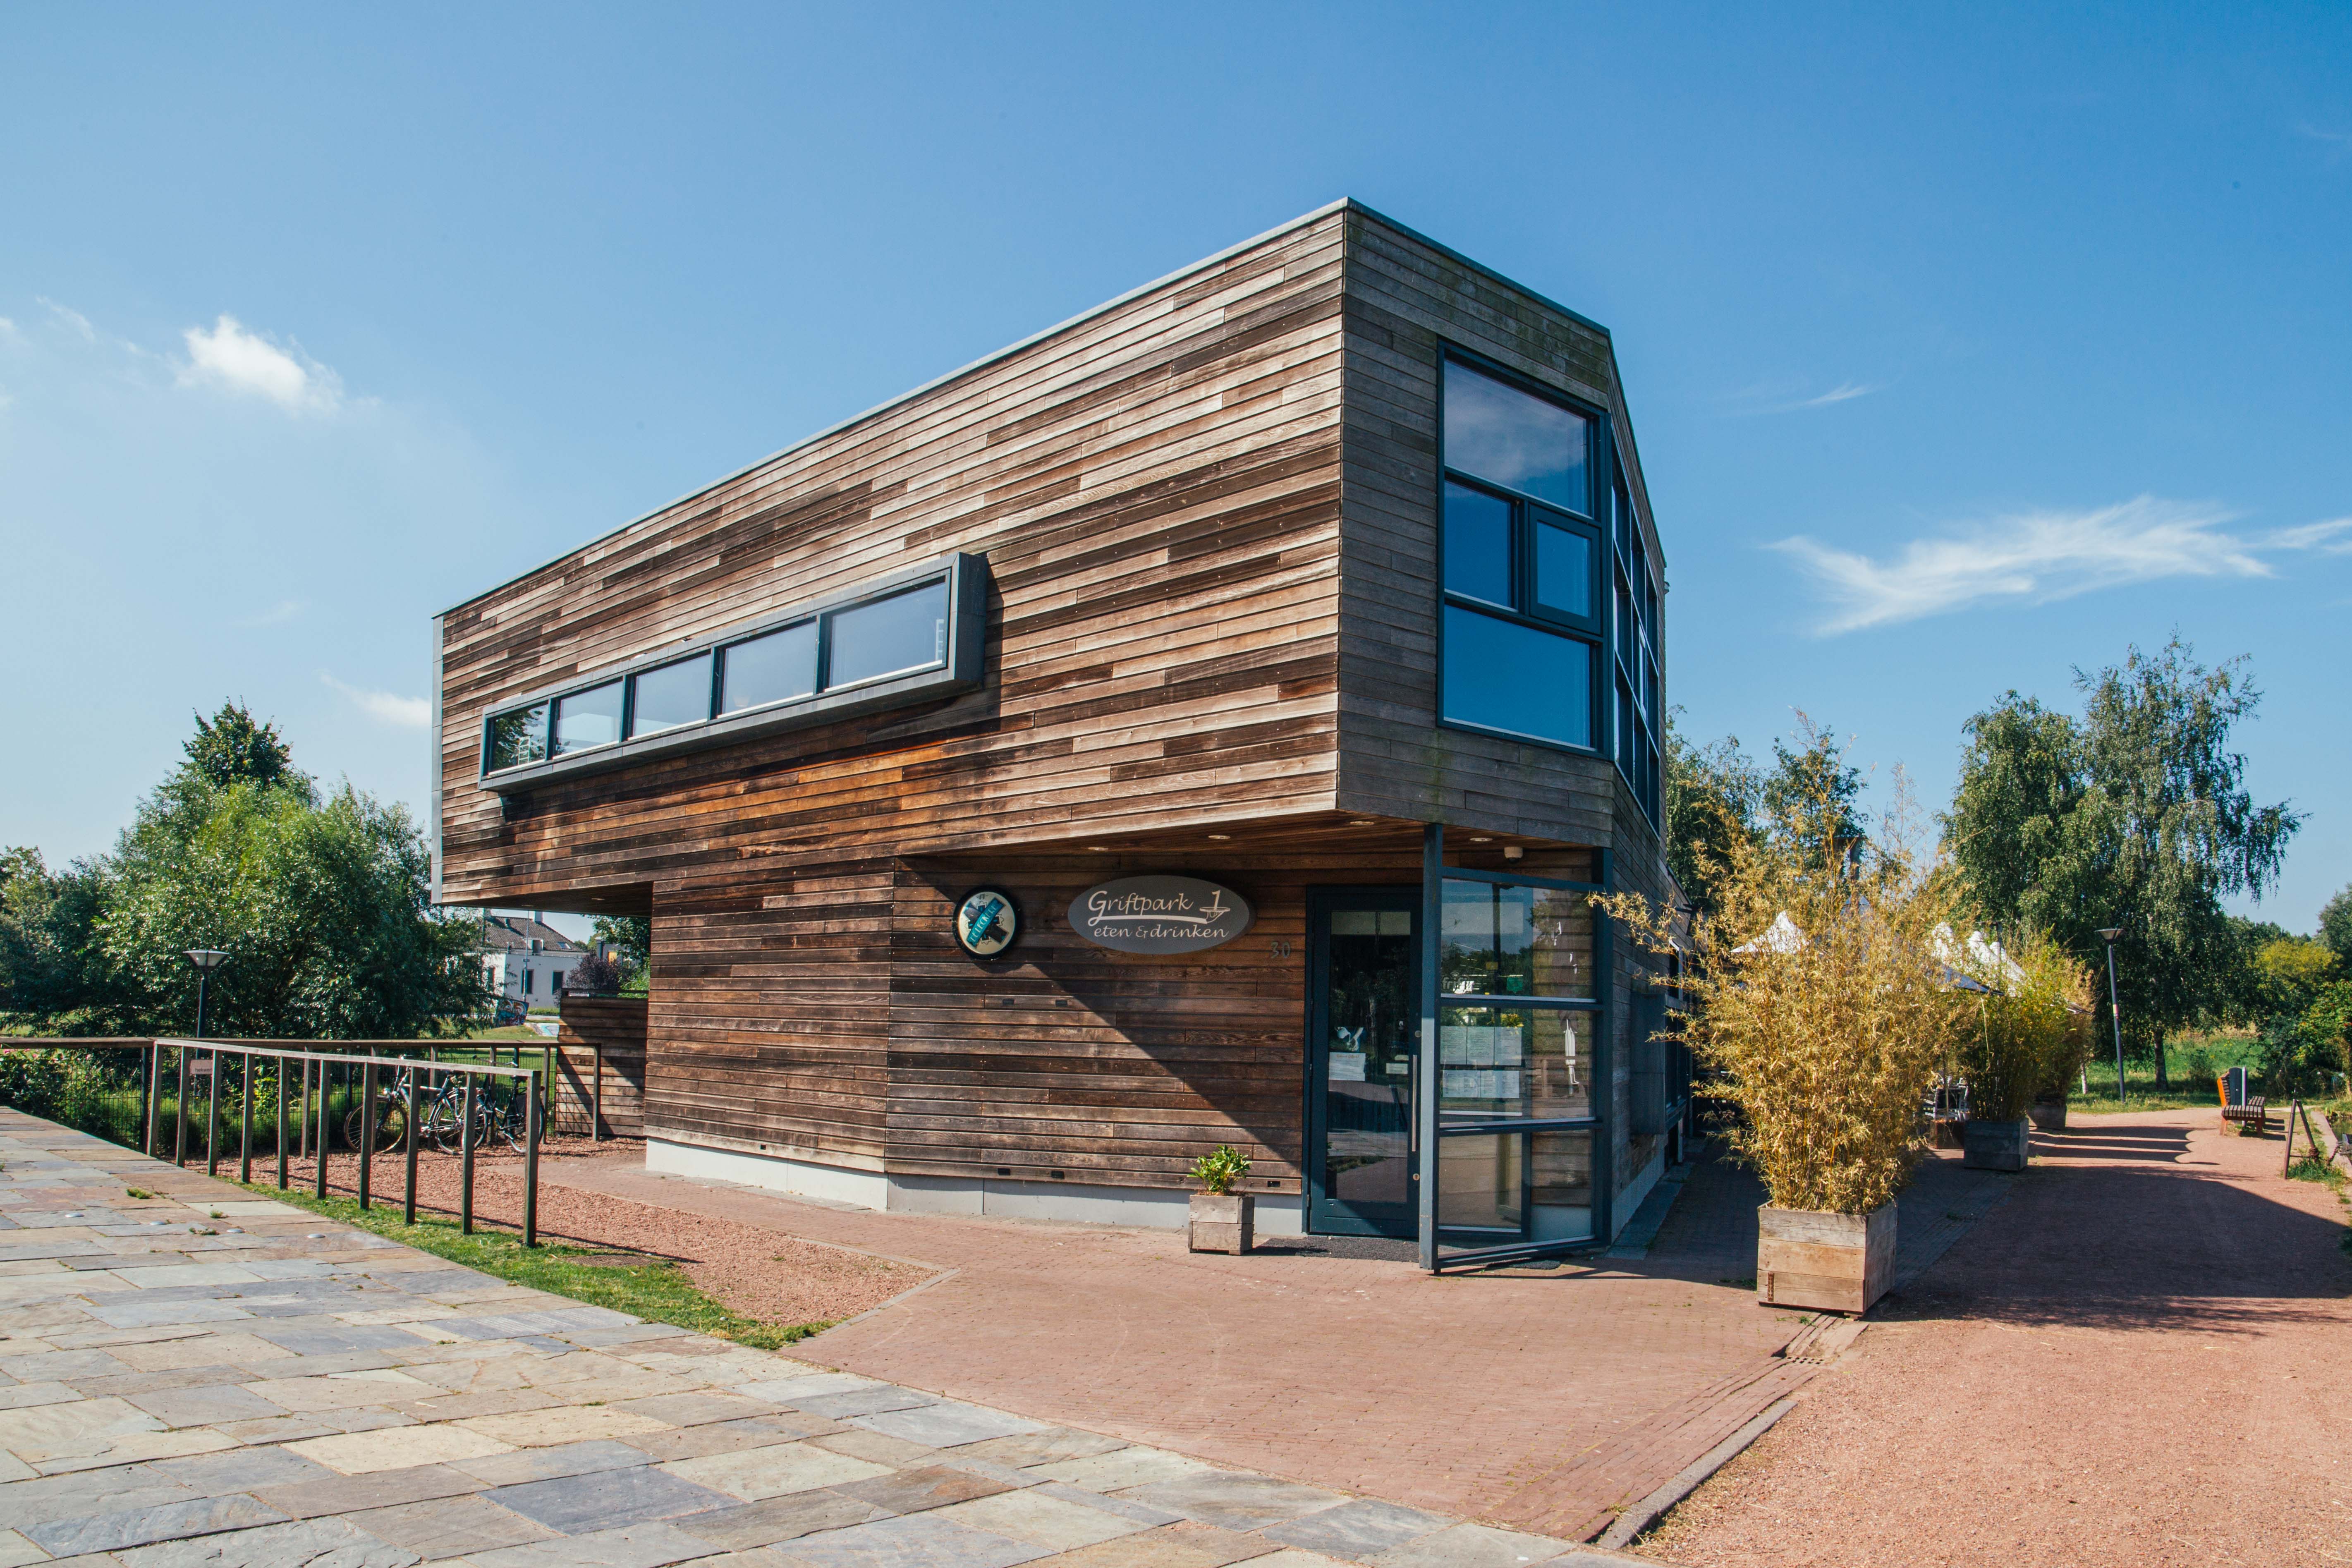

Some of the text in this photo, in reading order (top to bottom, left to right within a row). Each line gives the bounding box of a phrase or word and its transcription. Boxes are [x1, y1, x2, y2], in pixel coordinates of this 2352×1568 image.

[1088, 889, 1221, 926] Griftpark 1
[1093, 925, 1132, 938] eten
[1150, 924, 1229, 938] drinken
[1271, 941, 1290, 958] 30
